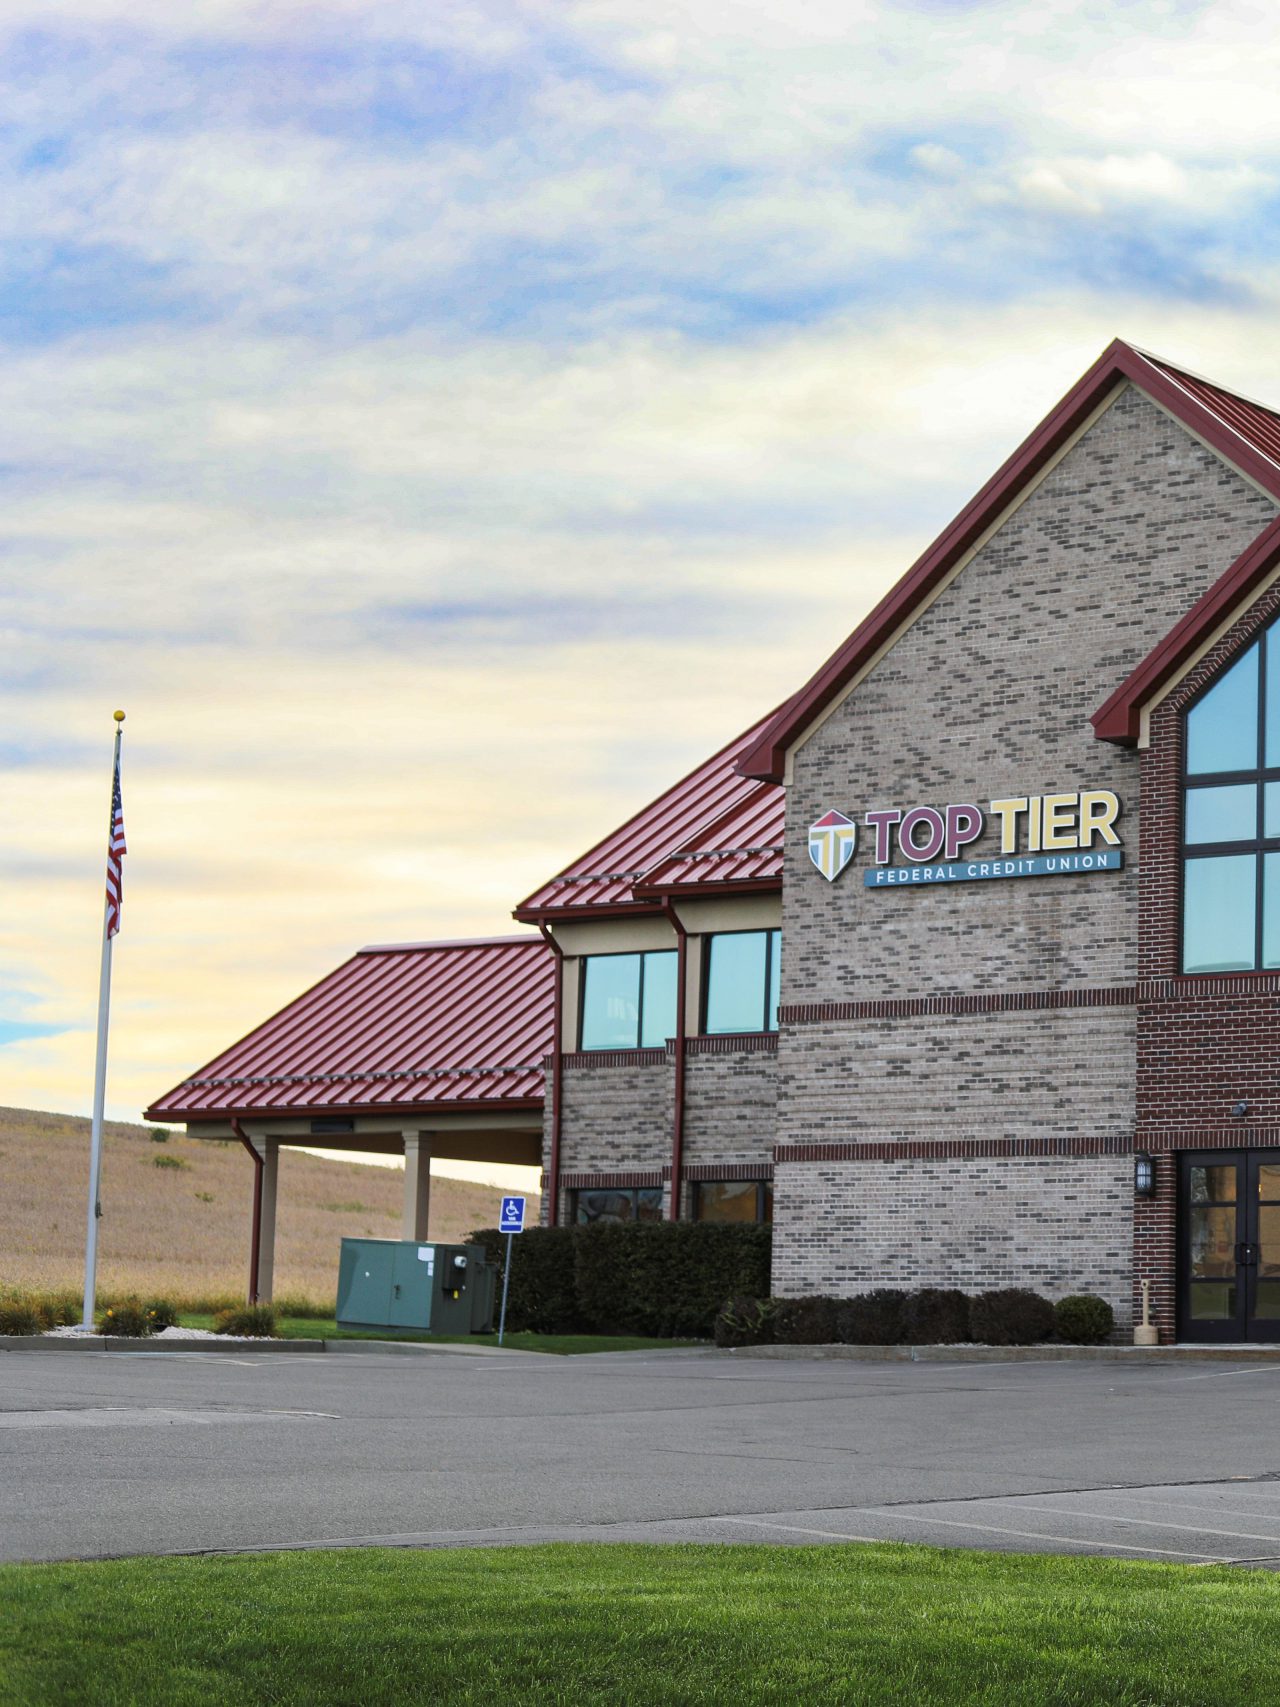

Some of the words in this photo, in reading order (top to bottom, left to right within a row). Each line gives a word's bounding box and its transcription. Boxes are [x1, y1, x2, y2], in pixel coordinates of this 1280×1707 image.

[865, 803, 983, 865] TOP
[990, 790, 1122, 854] TIER
[875, 866, 956, 884] FEDERAL
[967, 859, 1035, 877] CREDIT
[1046, 853, 1109, 871] UNION
